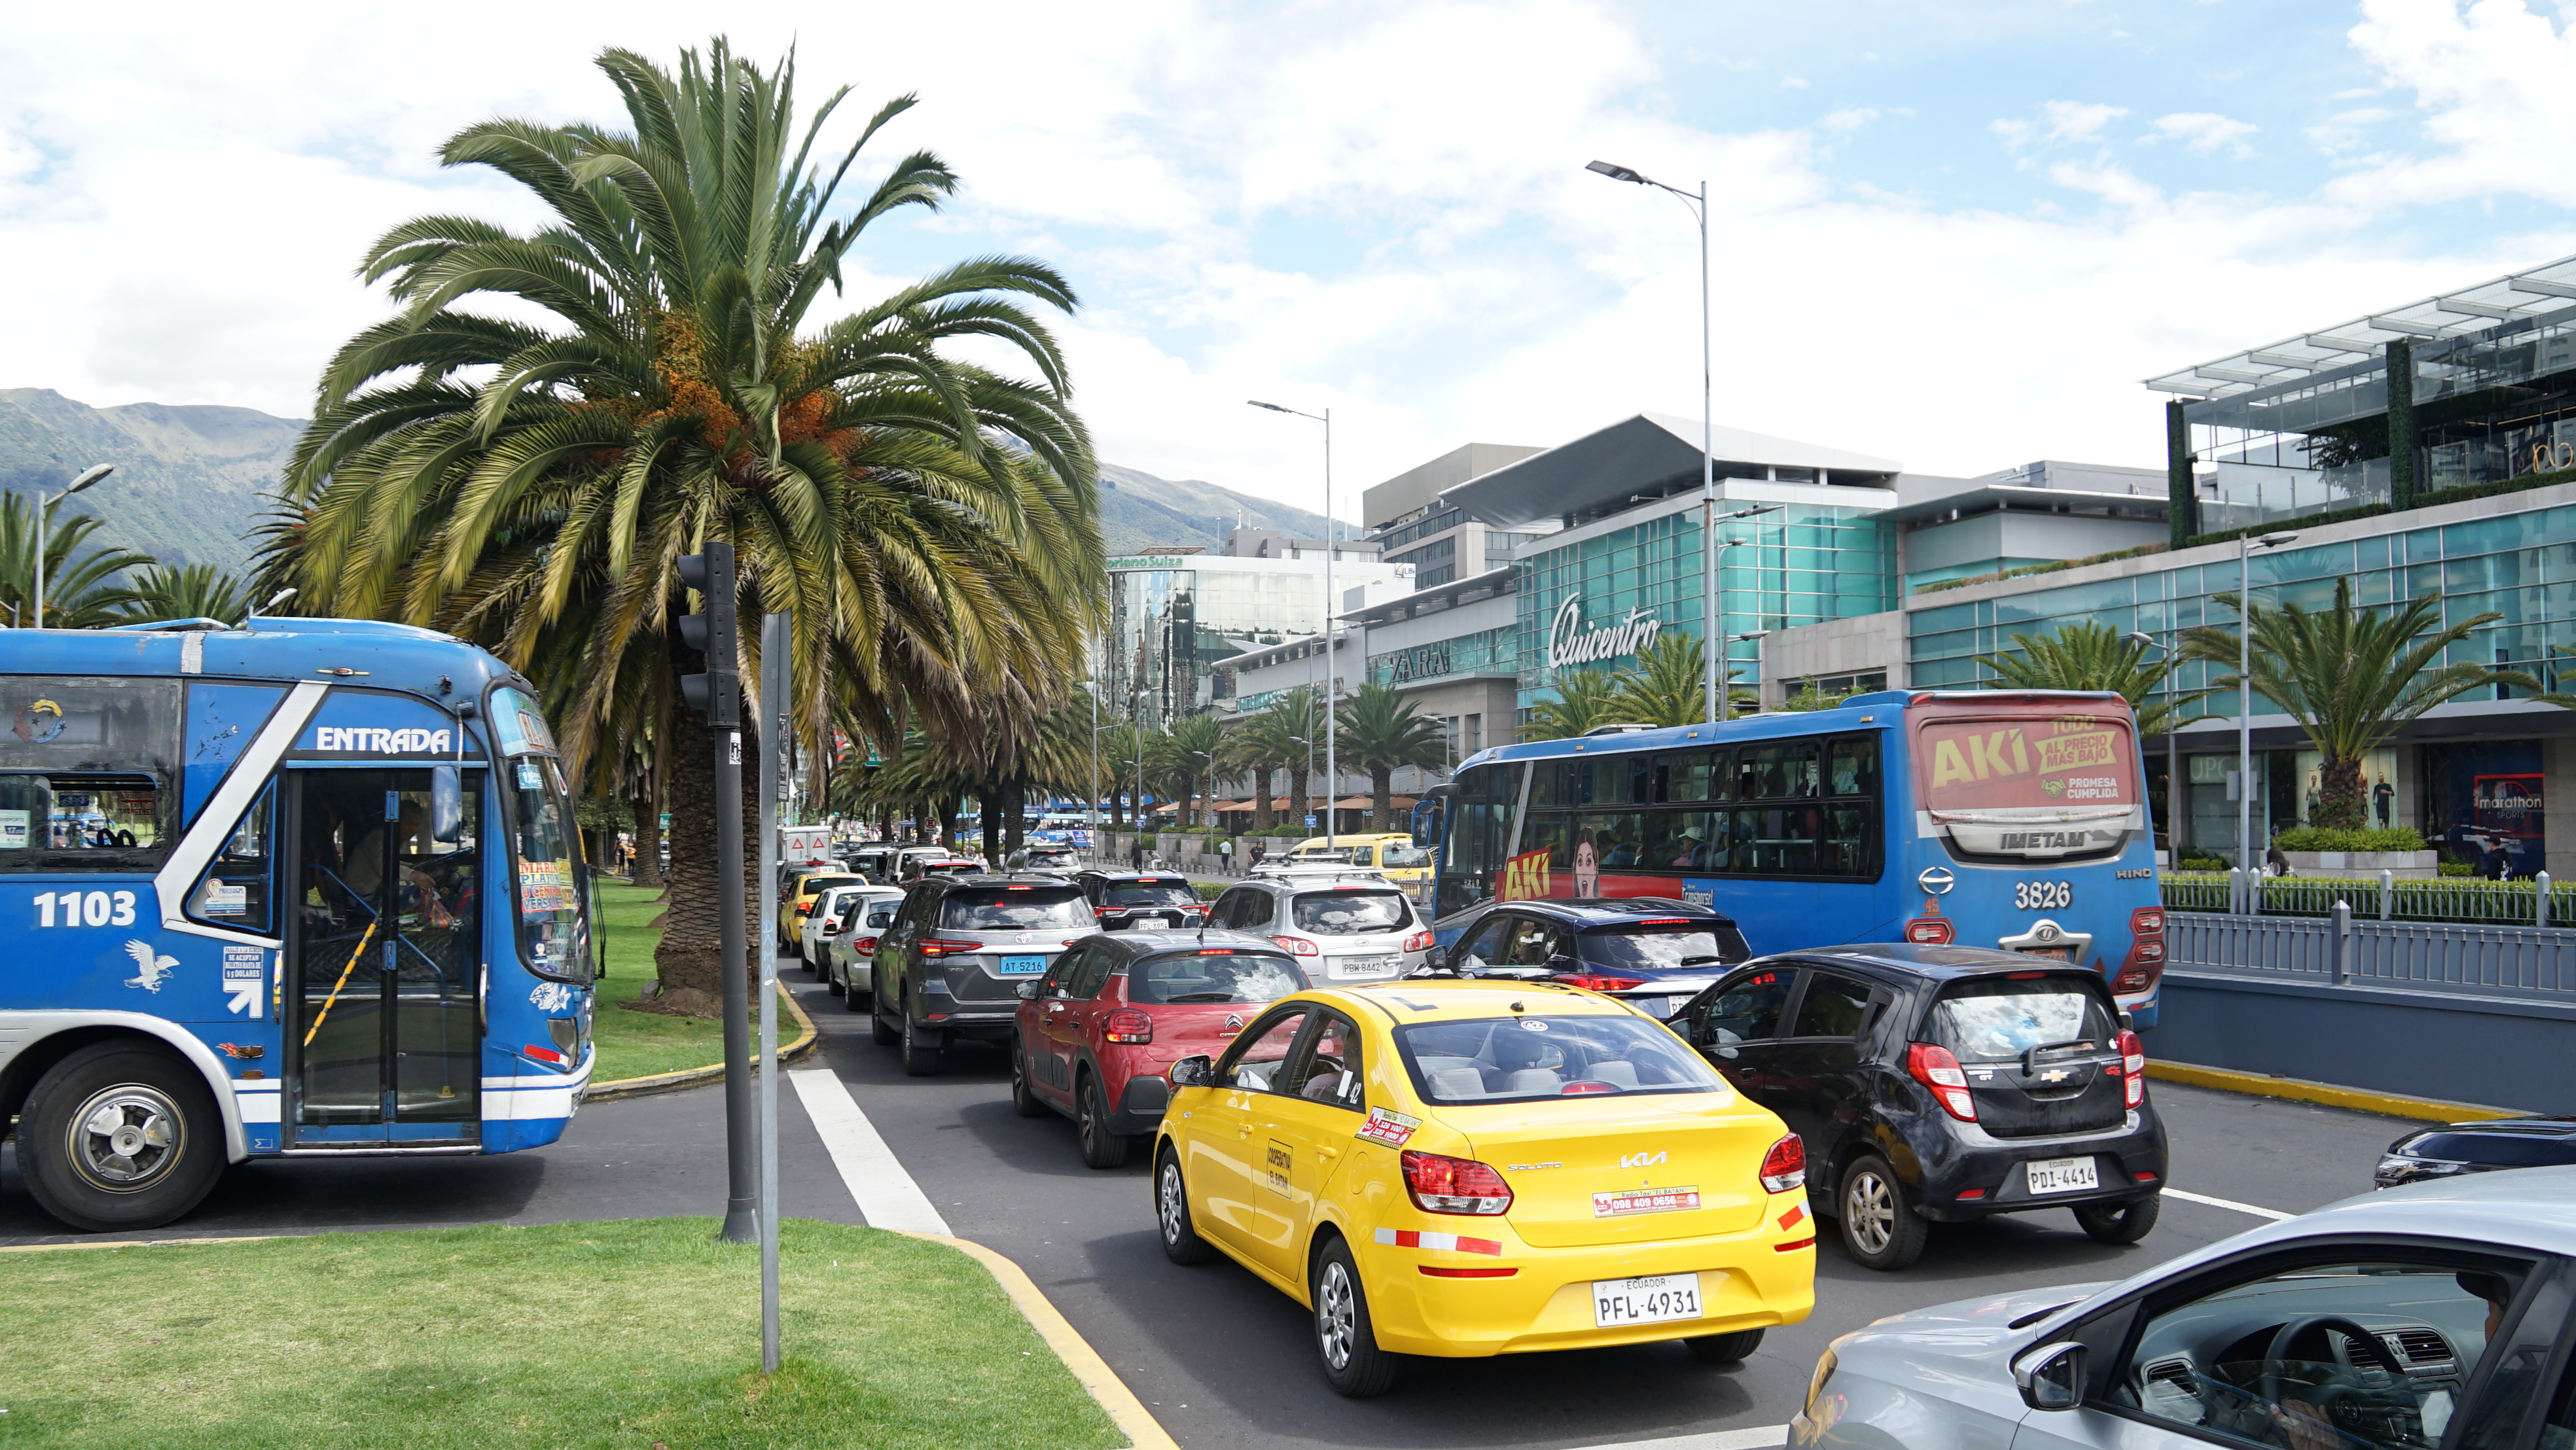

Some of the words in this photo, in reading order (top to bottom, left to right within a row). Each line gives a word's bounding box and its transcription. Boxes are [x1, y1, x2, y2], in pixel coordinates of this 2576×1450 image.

[1107, 558, 1147, 568] oriano
[1149, 556, 1183, 566] Suiza
[1548, 592, 1662, 669] Quicentro
[1390, 647, 1448, 682] ZARA
[2050, 714, 2096, 734] TODO
[316, 727, 451, 754] ENTRADA
[2045, 741, 2061, 755] AL
[2064, 734, 2107, 751] PRECIO
[2069, 777, 2117, 788] PROMESA
[2067, 788, 2119, 799] CUMPLIDA
[2479, 796, 2542, 809] marathon
[2001, 831, 2086, 849] IMETAM
[2116, 868, 2153, 879] HINO
[2014, 881, 2072, 910] 3826
[33, 891, 136, 927] 1103
[1005, 962, 1042, 972] AT-5216
[1344, 963, 1380, 972] PBW-8442
[1349, 1082, 1361, 1104] 42
[1507, 1161, 1562, 1171] SOLUTO
[2049, 1159, 2074, 1168] ECUADOR
[2031, 1167, 2094, 1189] PDI-4414
[1613, 1199, 1632, 1210] 098
[1634, 1197, 1651, 1207] 409
[1653, 1196, 1676, 1206] 0656
[1626, 1278, 1666, 1290] ECUADOR
[1599, 1290, 1698, 1320] PFL-4931
